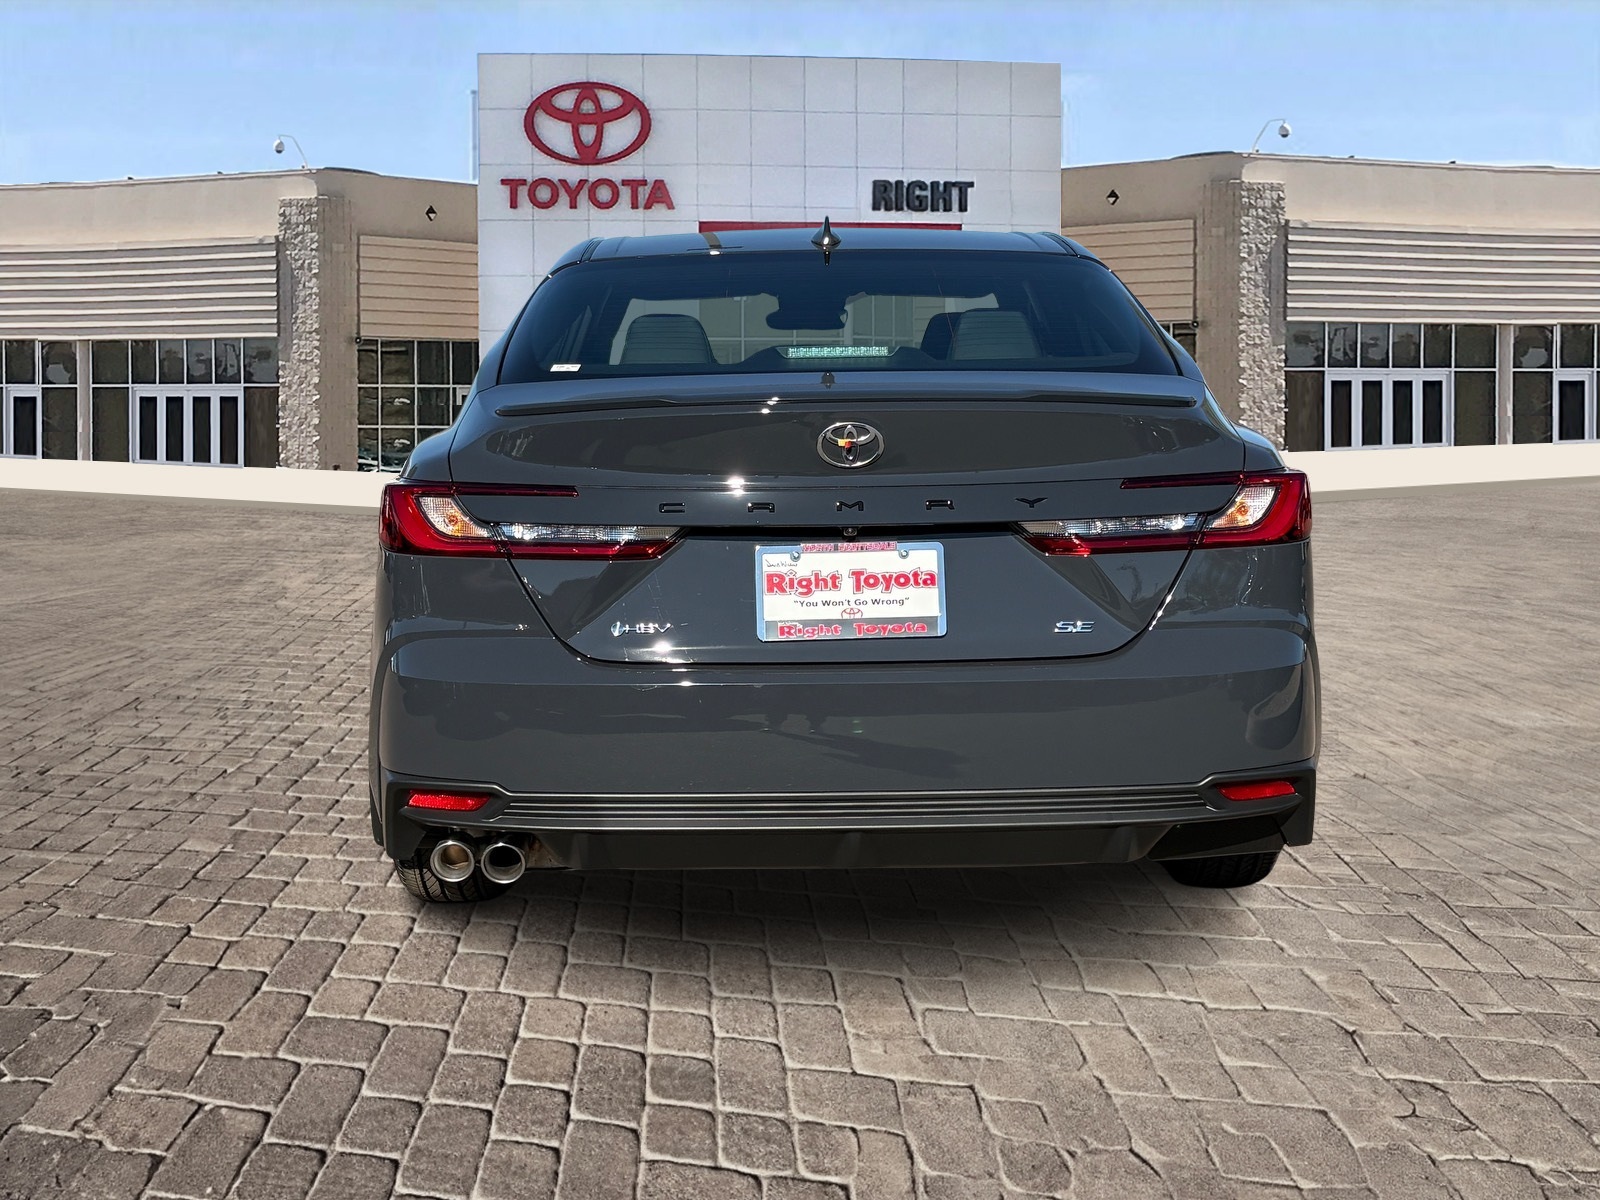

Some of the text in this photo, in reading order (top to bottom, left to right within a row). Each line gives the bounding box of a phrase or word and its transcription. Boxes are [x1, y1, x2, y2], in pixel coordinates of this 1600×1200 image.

[500, 177, 675, 209] TOYOTA
[871, 179, 975, 212] RIGHT
[658, 497, 1049, 514] CAMRY
[765, 567, 938, 597] Right Toyota
[778, 622, 927, 639] Right Toyota
[1054, 620, 1095, 633] SE
